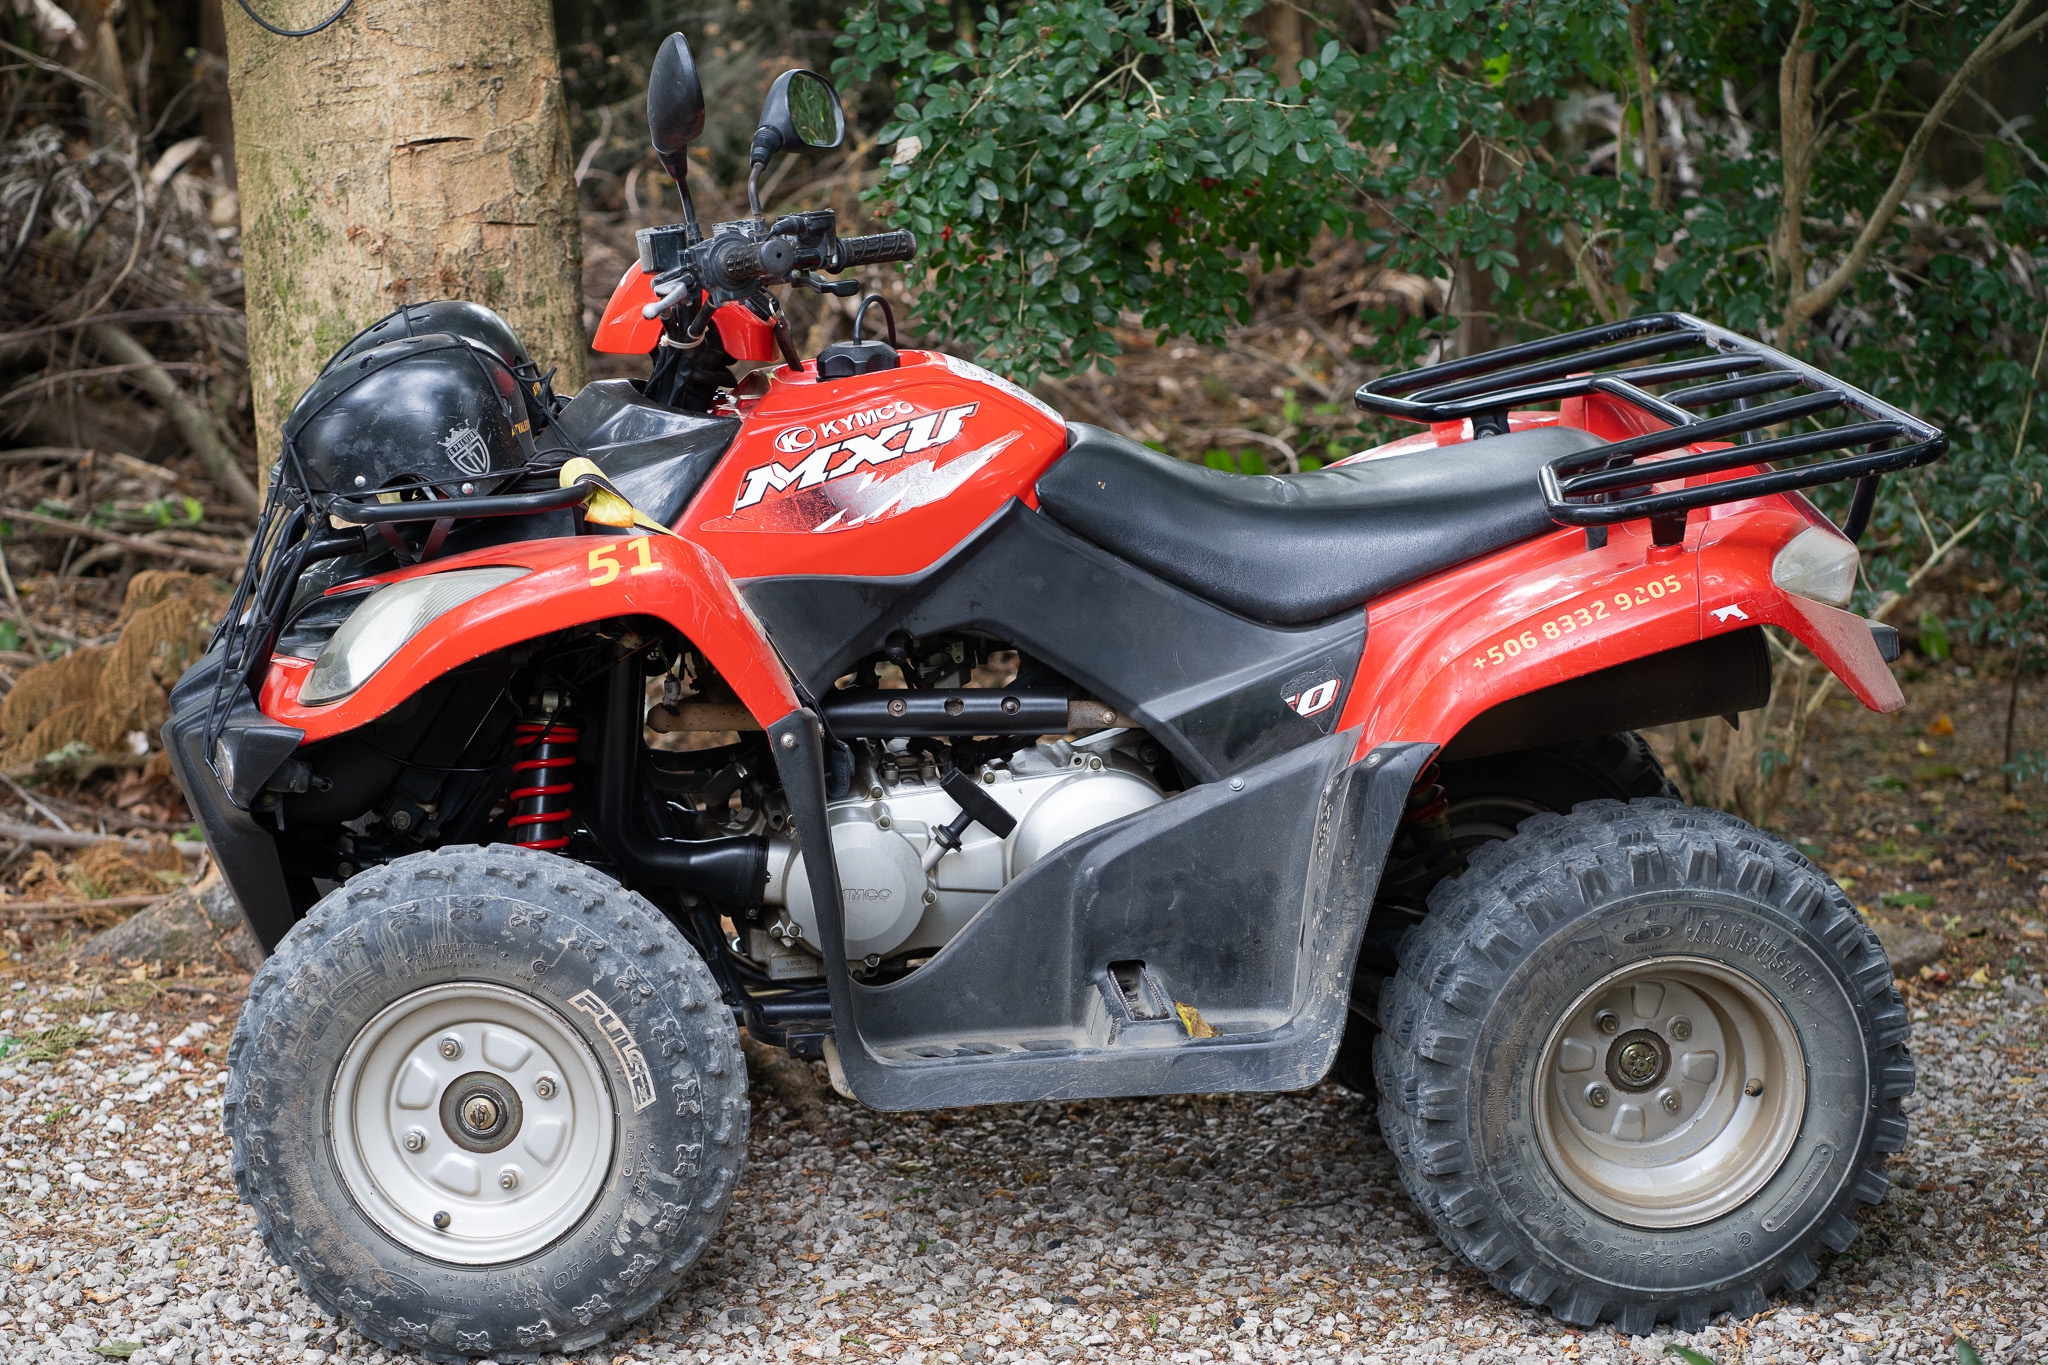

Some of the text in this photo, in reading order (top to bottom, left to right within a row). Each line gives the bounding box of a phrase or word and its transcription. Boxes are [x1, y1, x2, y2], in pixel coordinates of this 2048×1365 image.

[736, 403, 978, 510] MXU
[820, 401, 915, 438] KYMCO
[588, 536, 663, 587] 51
[1472, 574, 1682, 669] +506 8332 9205
[566, 988, 658, 1114] PULSE
